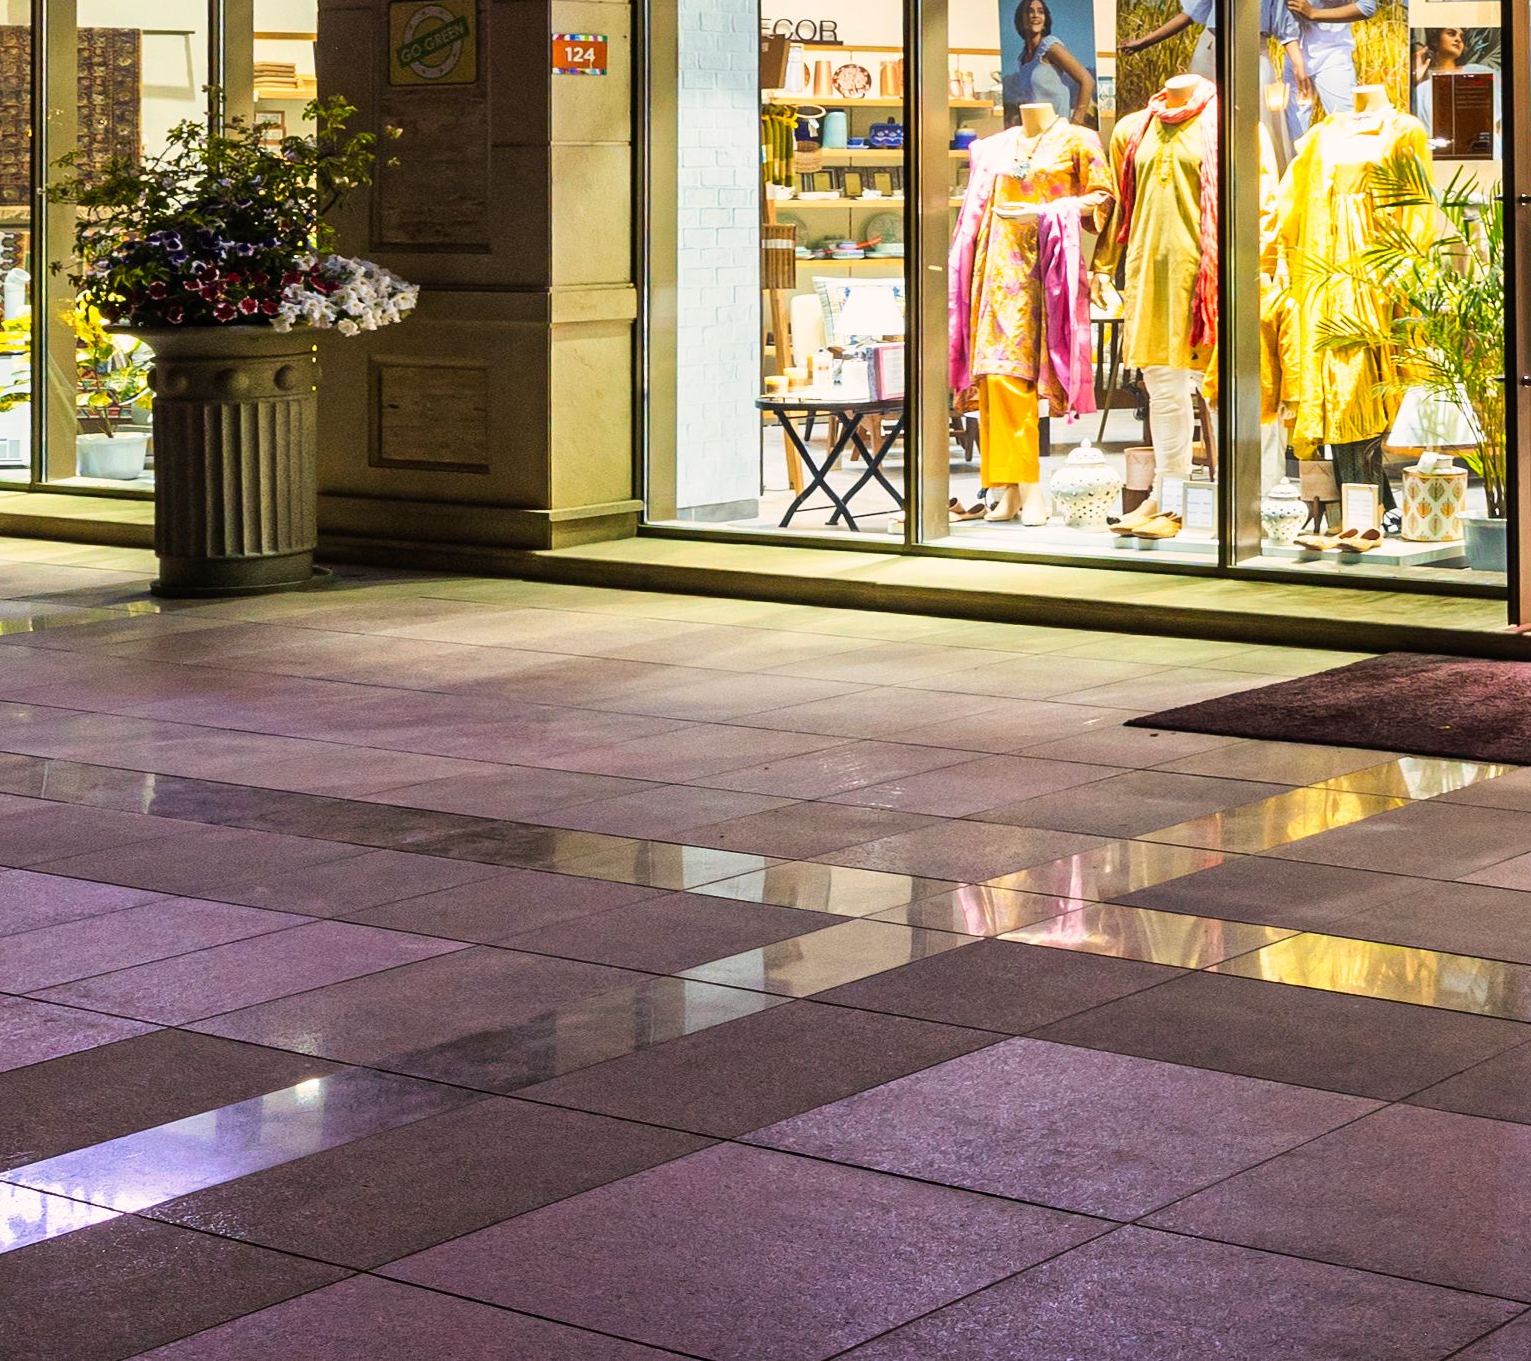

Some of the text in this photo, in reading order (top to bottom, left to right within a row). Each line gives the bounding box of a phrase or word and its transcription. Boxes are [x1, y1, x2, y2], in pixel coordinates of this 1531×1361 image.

[400, 21, 466, 63] GO GREEN
[565, 46, 596, 63] 124
